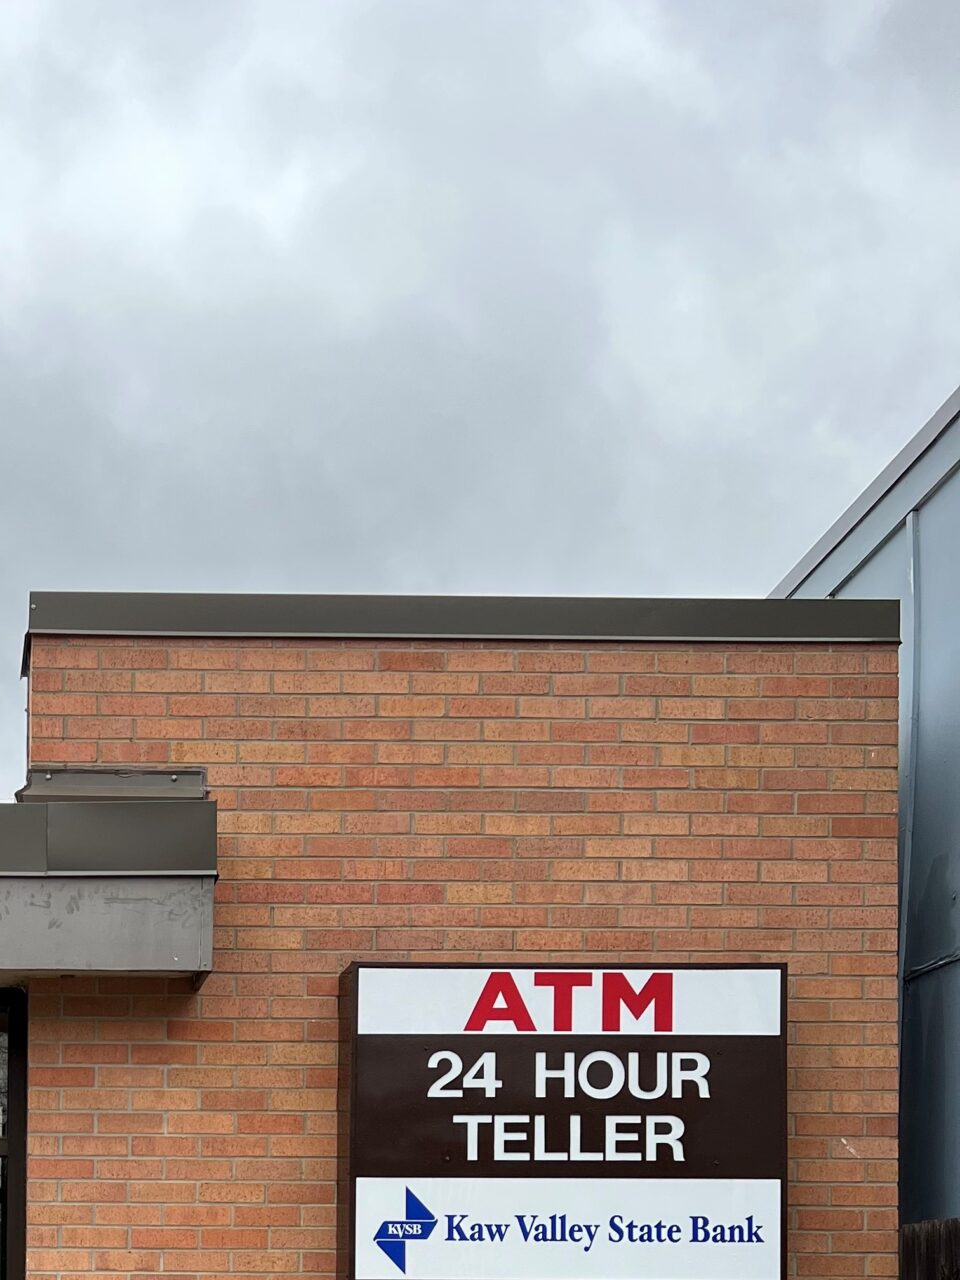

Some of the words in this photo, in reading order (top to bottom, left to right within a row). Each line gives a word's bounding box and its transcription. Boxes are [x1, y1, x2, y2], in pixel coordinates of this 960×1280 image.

[464, 972, 674, 1032] ATM
[427, 1050, 503, 1098] 24
[535, 1050, 711, 1100] HOUR
[452, 1114, 685, 1162] TELLER
[388, 1224, 421, 1238] KVSB
[445, 1215, 510, 1241] Kaw
[515, 1214, 600, 1252] Valley
[609, 1215, 681, 1243] State
[689, 1216, 764, 1243] Bank
